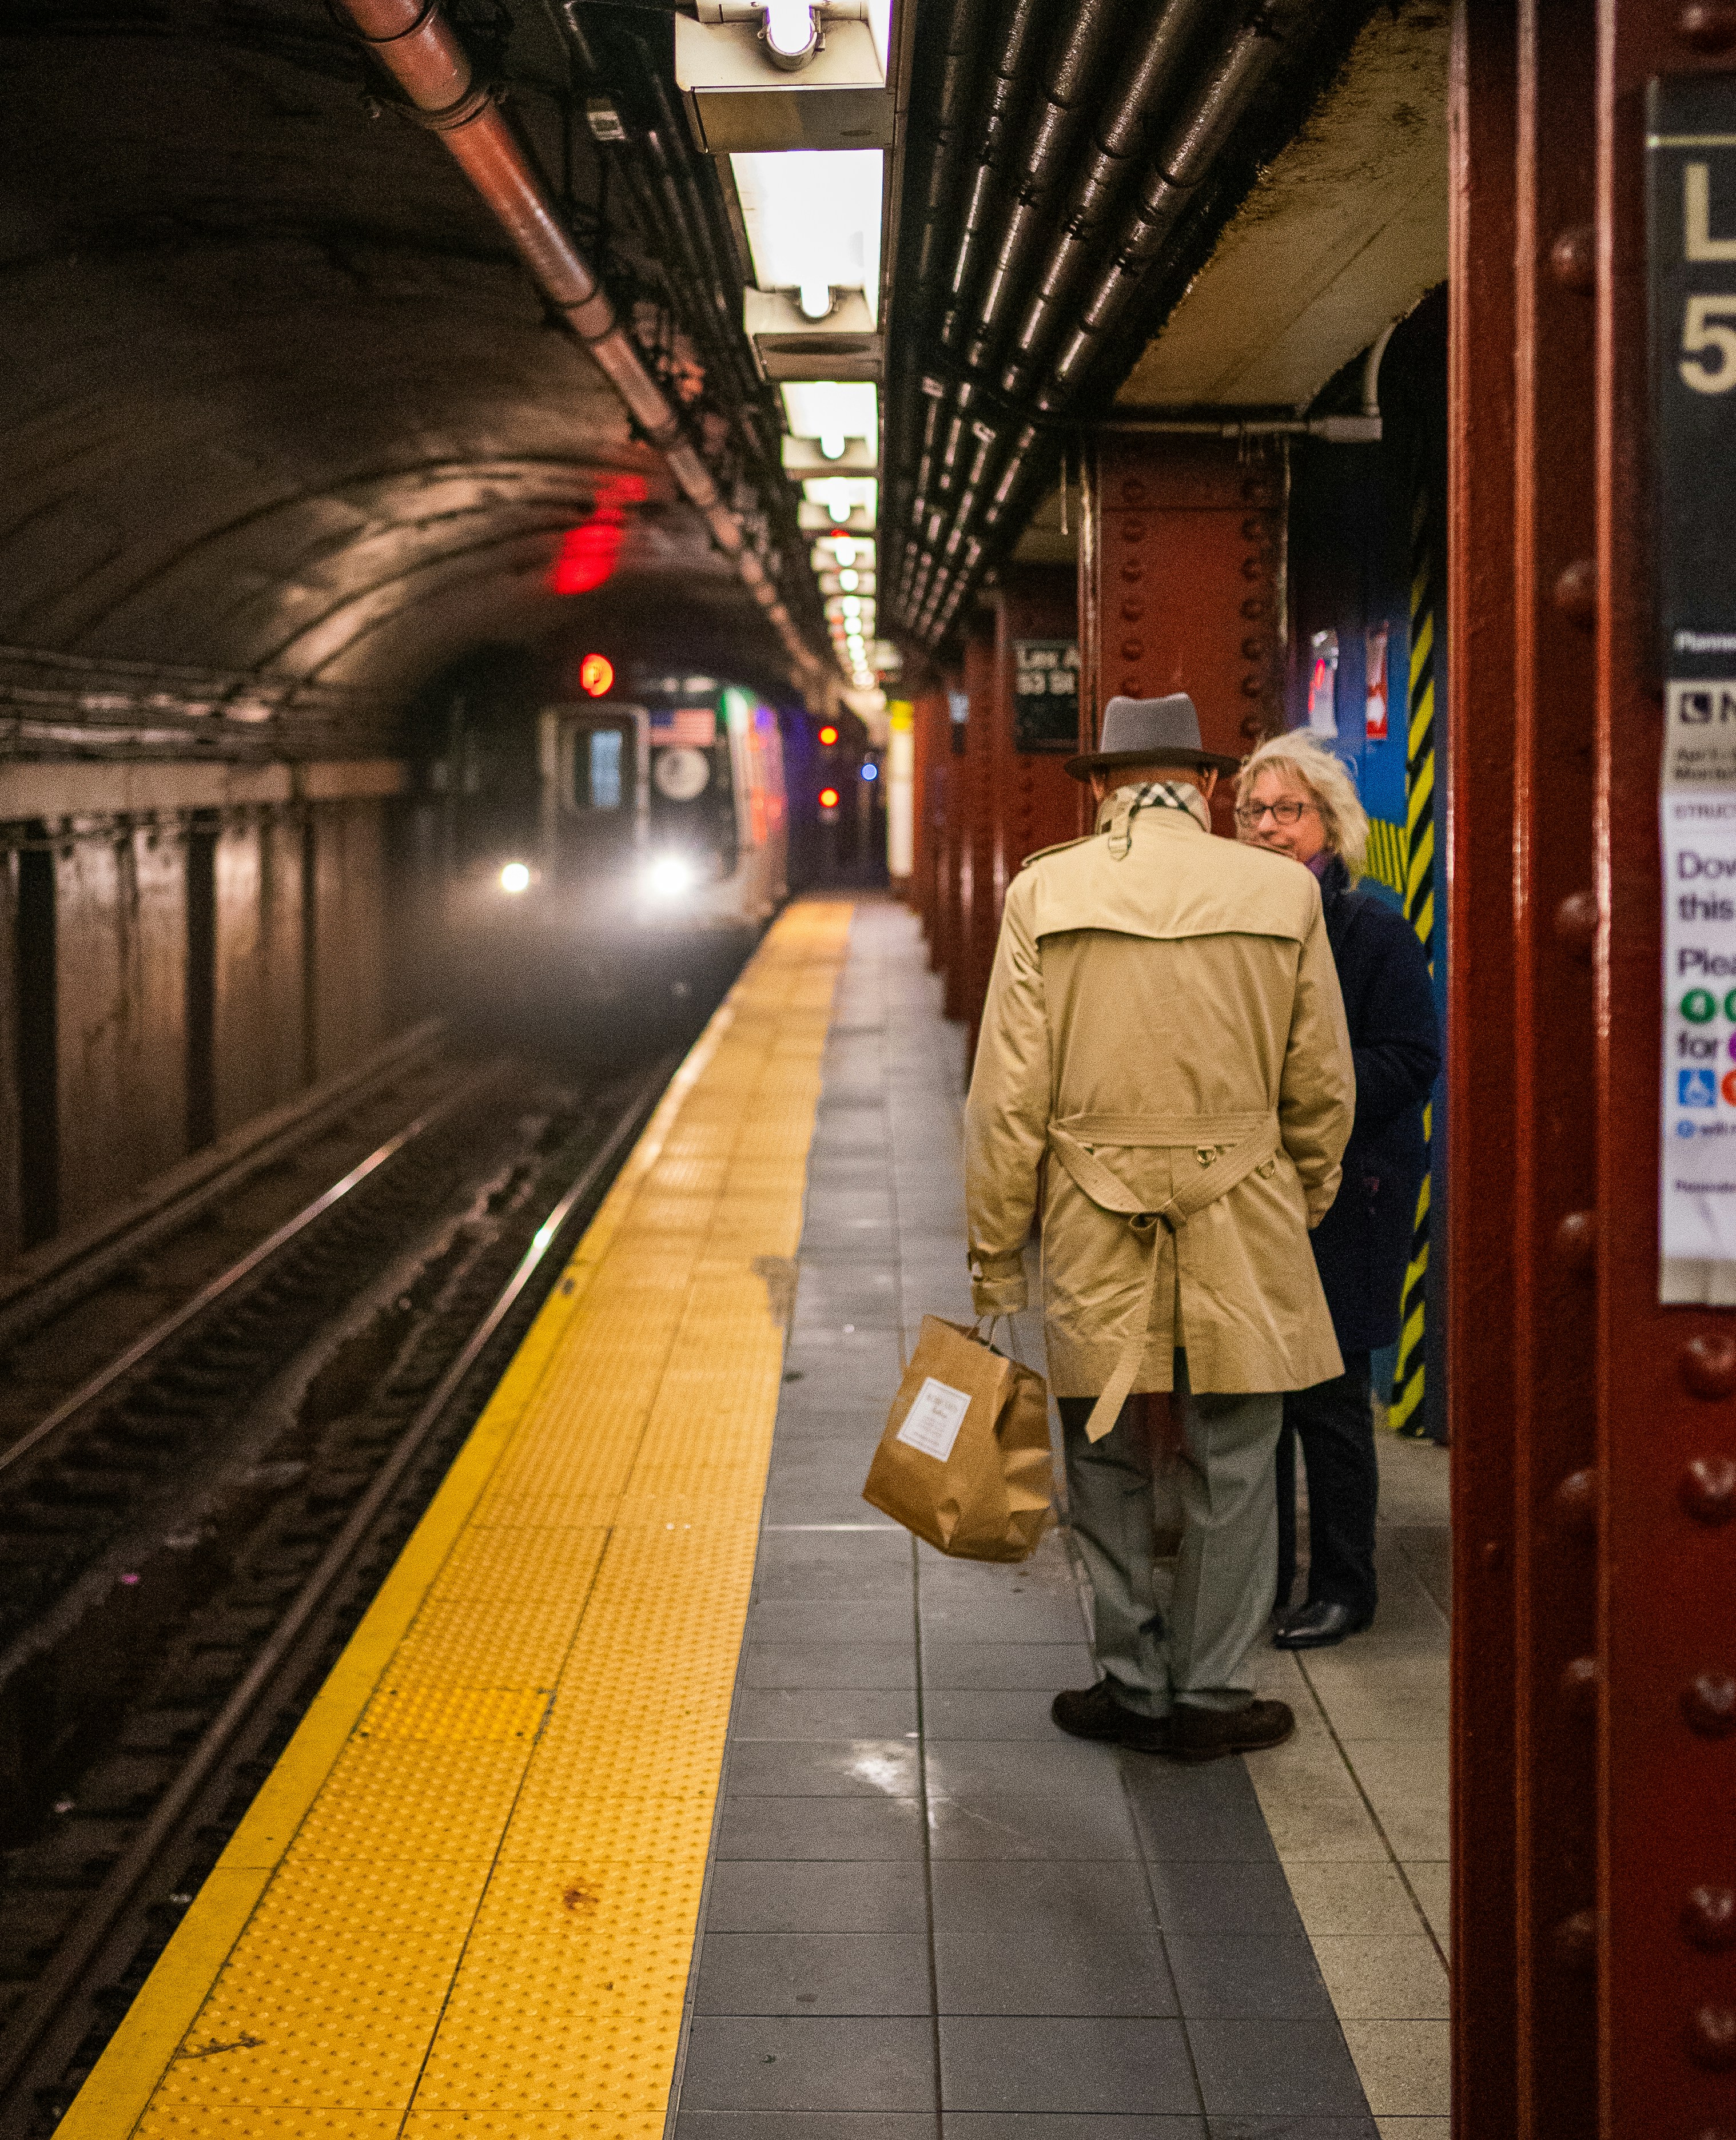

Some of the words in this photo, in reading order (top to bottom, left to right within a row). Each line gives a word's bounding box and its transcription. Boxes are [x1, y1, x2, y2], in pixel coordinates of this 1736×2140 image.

[1685, 162, 1736, 261] L
[1679, 295, 1736, 393] 5
[1678, 892, 1734, 922] this
